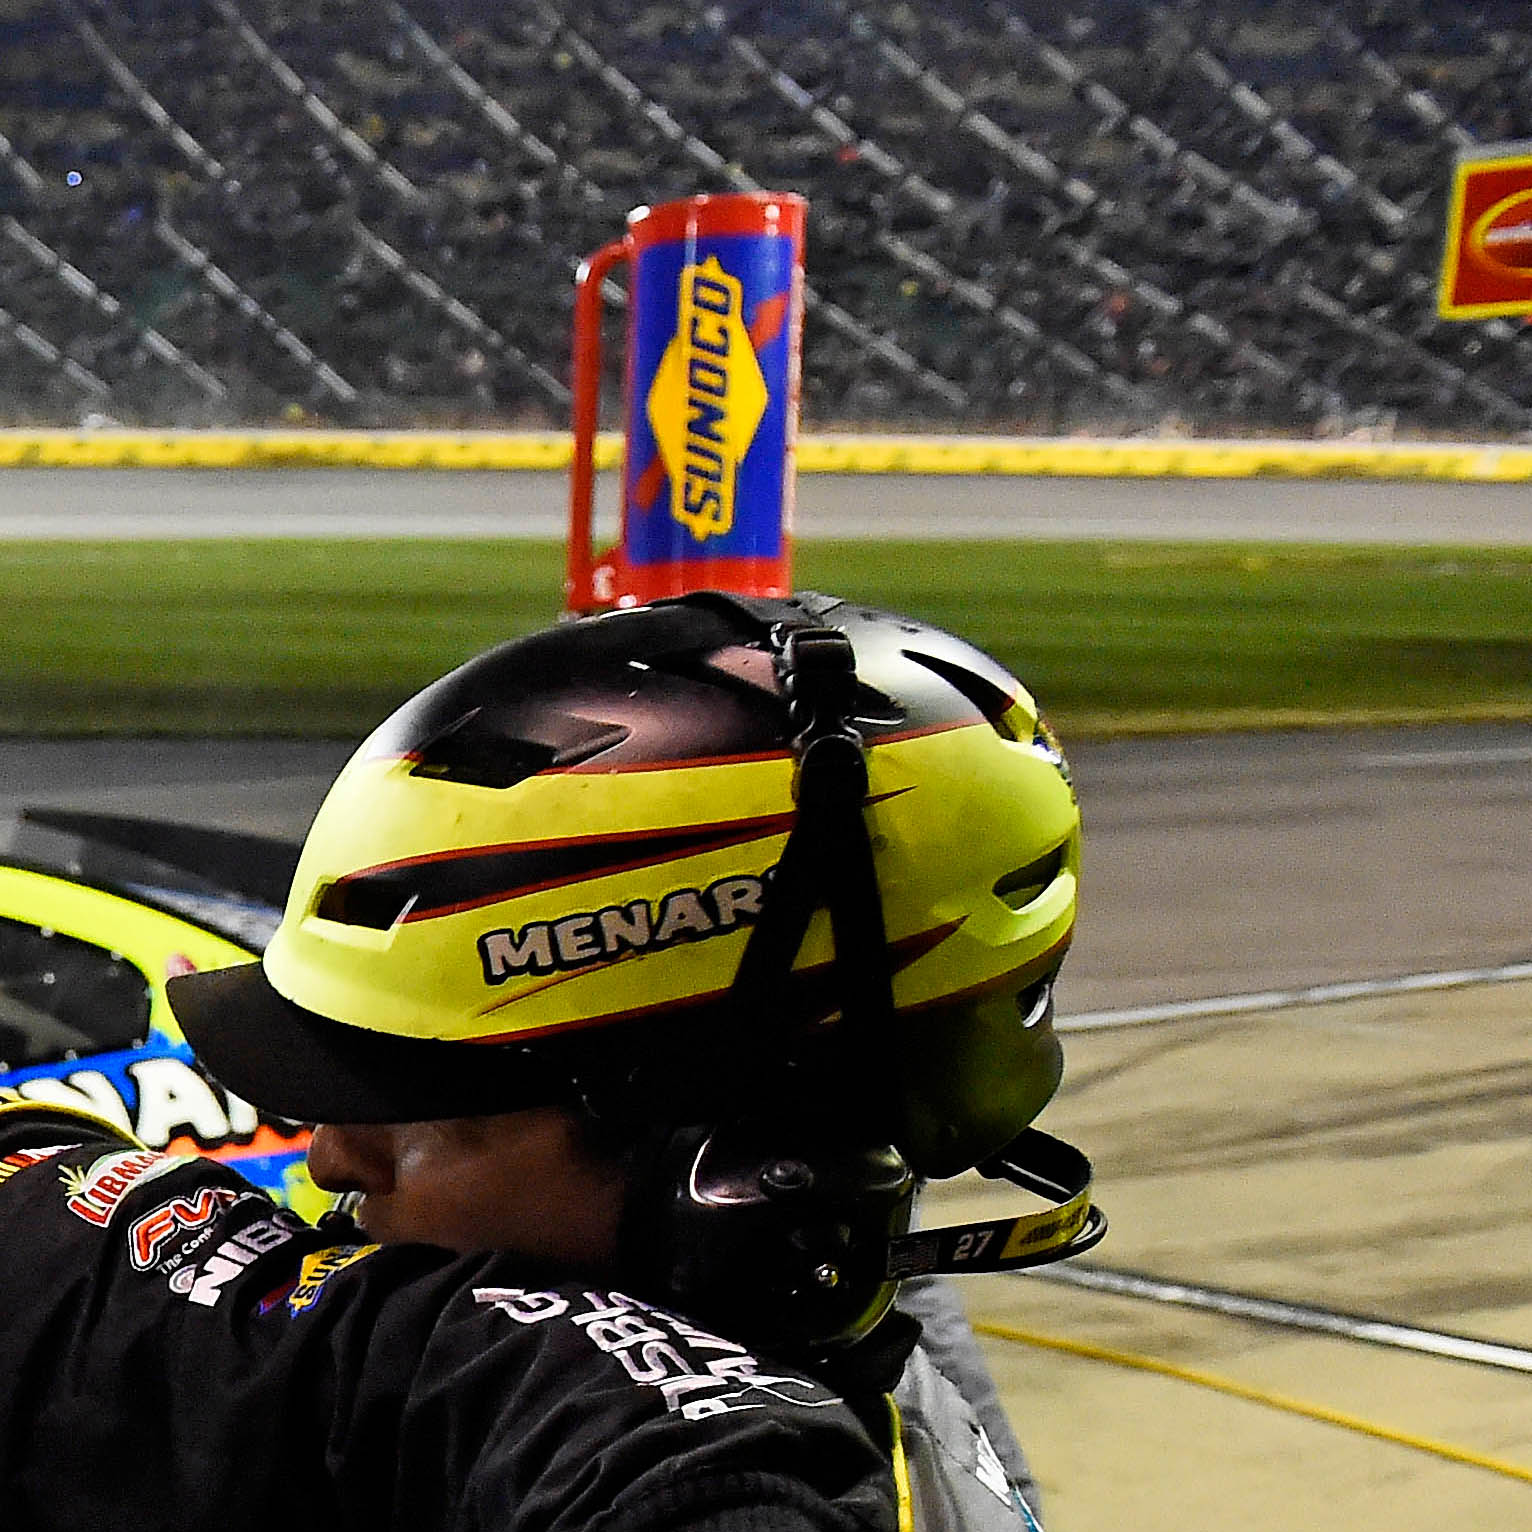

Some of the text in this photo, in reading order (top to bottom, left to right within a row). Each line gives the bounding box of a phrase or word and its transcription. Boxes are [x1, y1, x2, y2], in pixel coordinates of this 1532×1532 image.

[683, 276, 731, 520] SUNOCO
[484, 866, 778, 976] MENAR
[952, 1230, 994, 1262] 27
